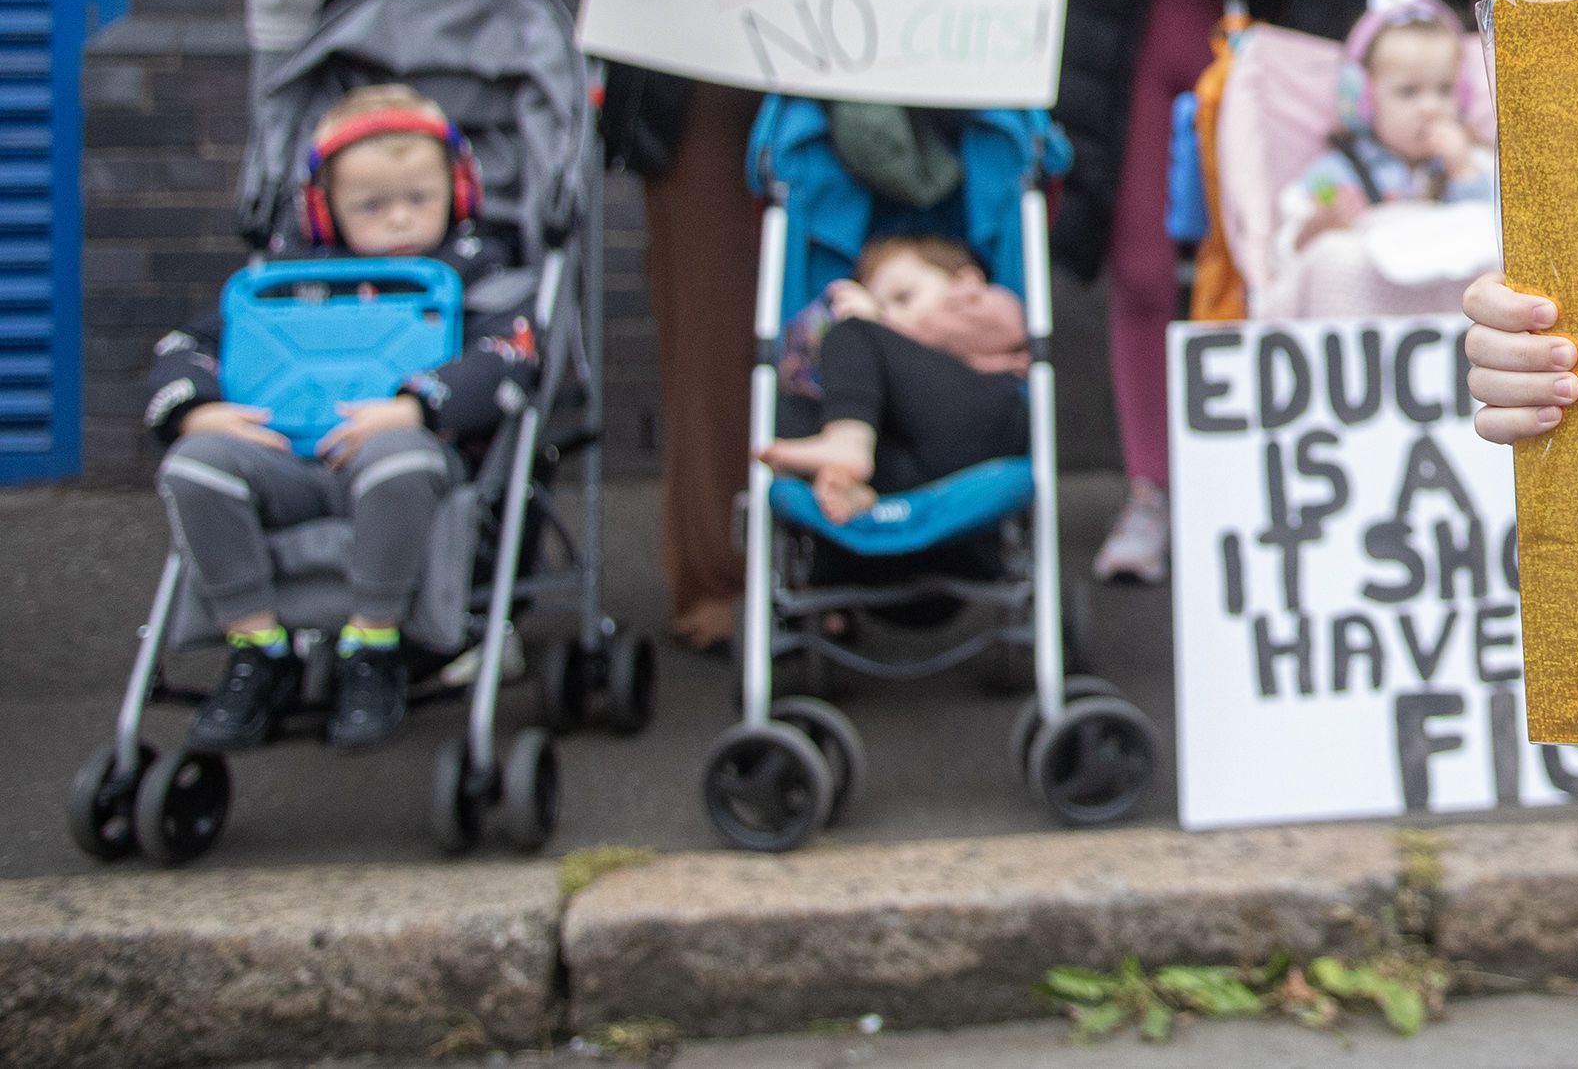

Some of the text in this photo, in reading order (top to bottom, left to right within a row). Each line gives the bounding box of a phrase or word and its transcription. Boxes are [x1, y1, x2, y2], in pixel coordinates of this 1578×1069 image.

[1184, 328, 1474, 432] EDUC
[1264, 430, 1480, 528] IS A
[1220, 520, 1519, 614] IT SH
[1251, 603, 1520, 700] HAVE
